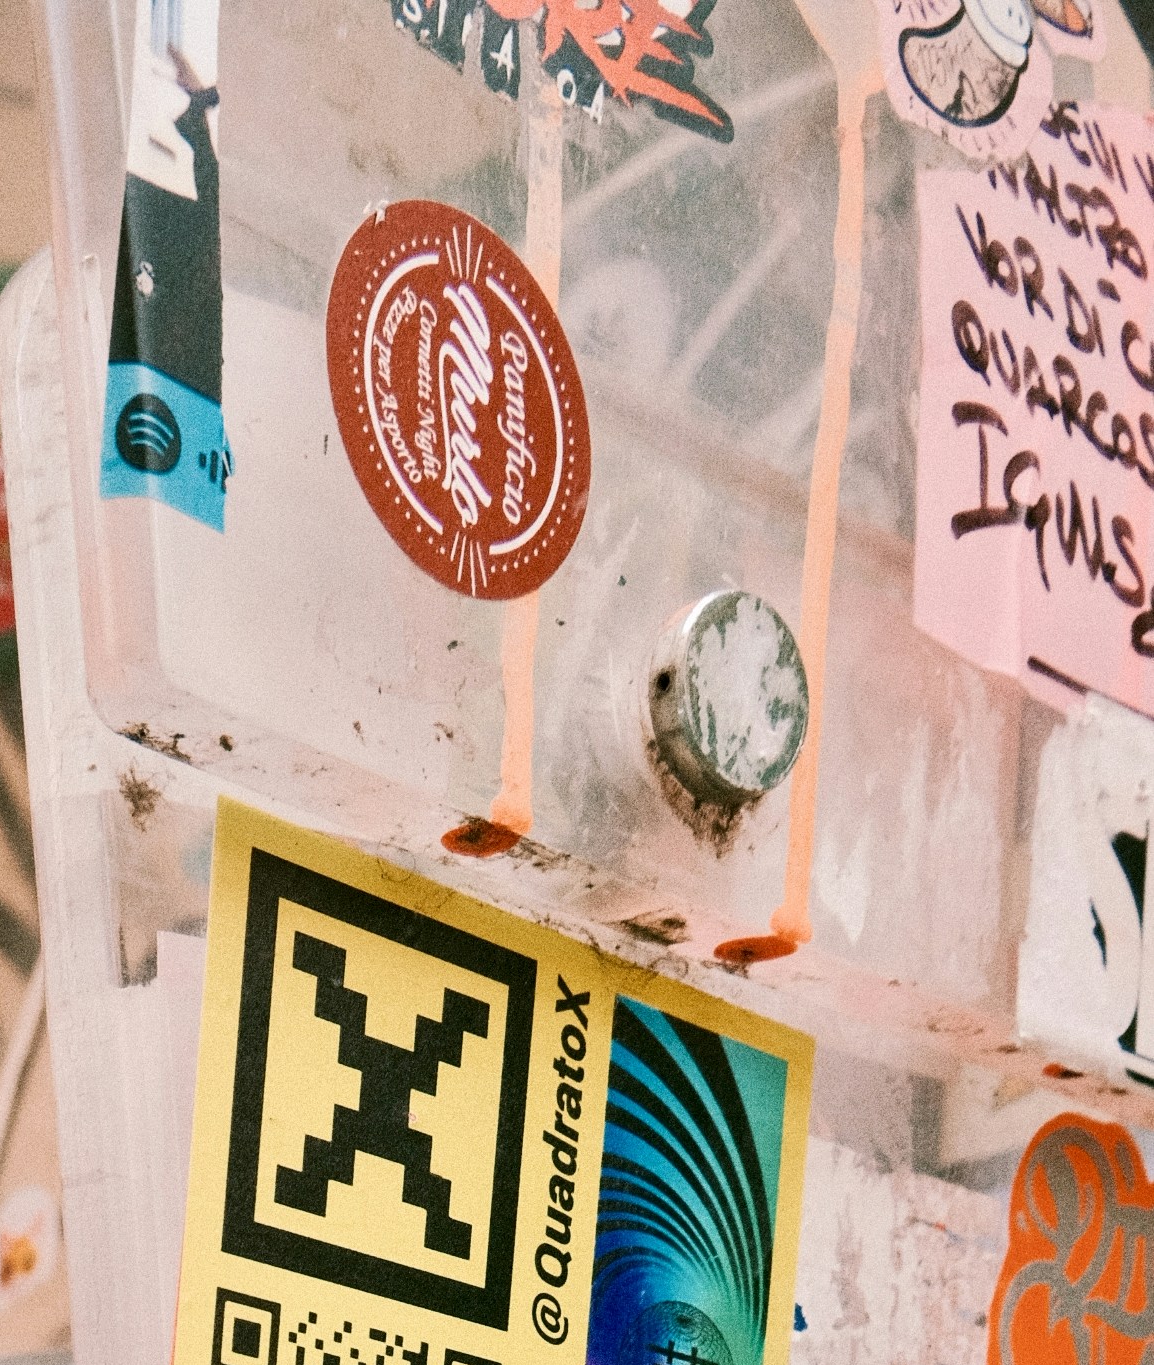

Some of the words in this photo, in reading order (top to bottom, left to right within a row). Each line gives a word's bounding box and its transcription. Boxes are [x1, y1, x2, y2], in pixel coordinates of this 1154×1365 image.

[372, 339, 392, 388] per
[375, 381, 423, 484] Asporto
[414, 399, 439, 481] Night
[497, 331, 537, 526] Panificio
[530, 974, 592, 1346] @QuadratoX
